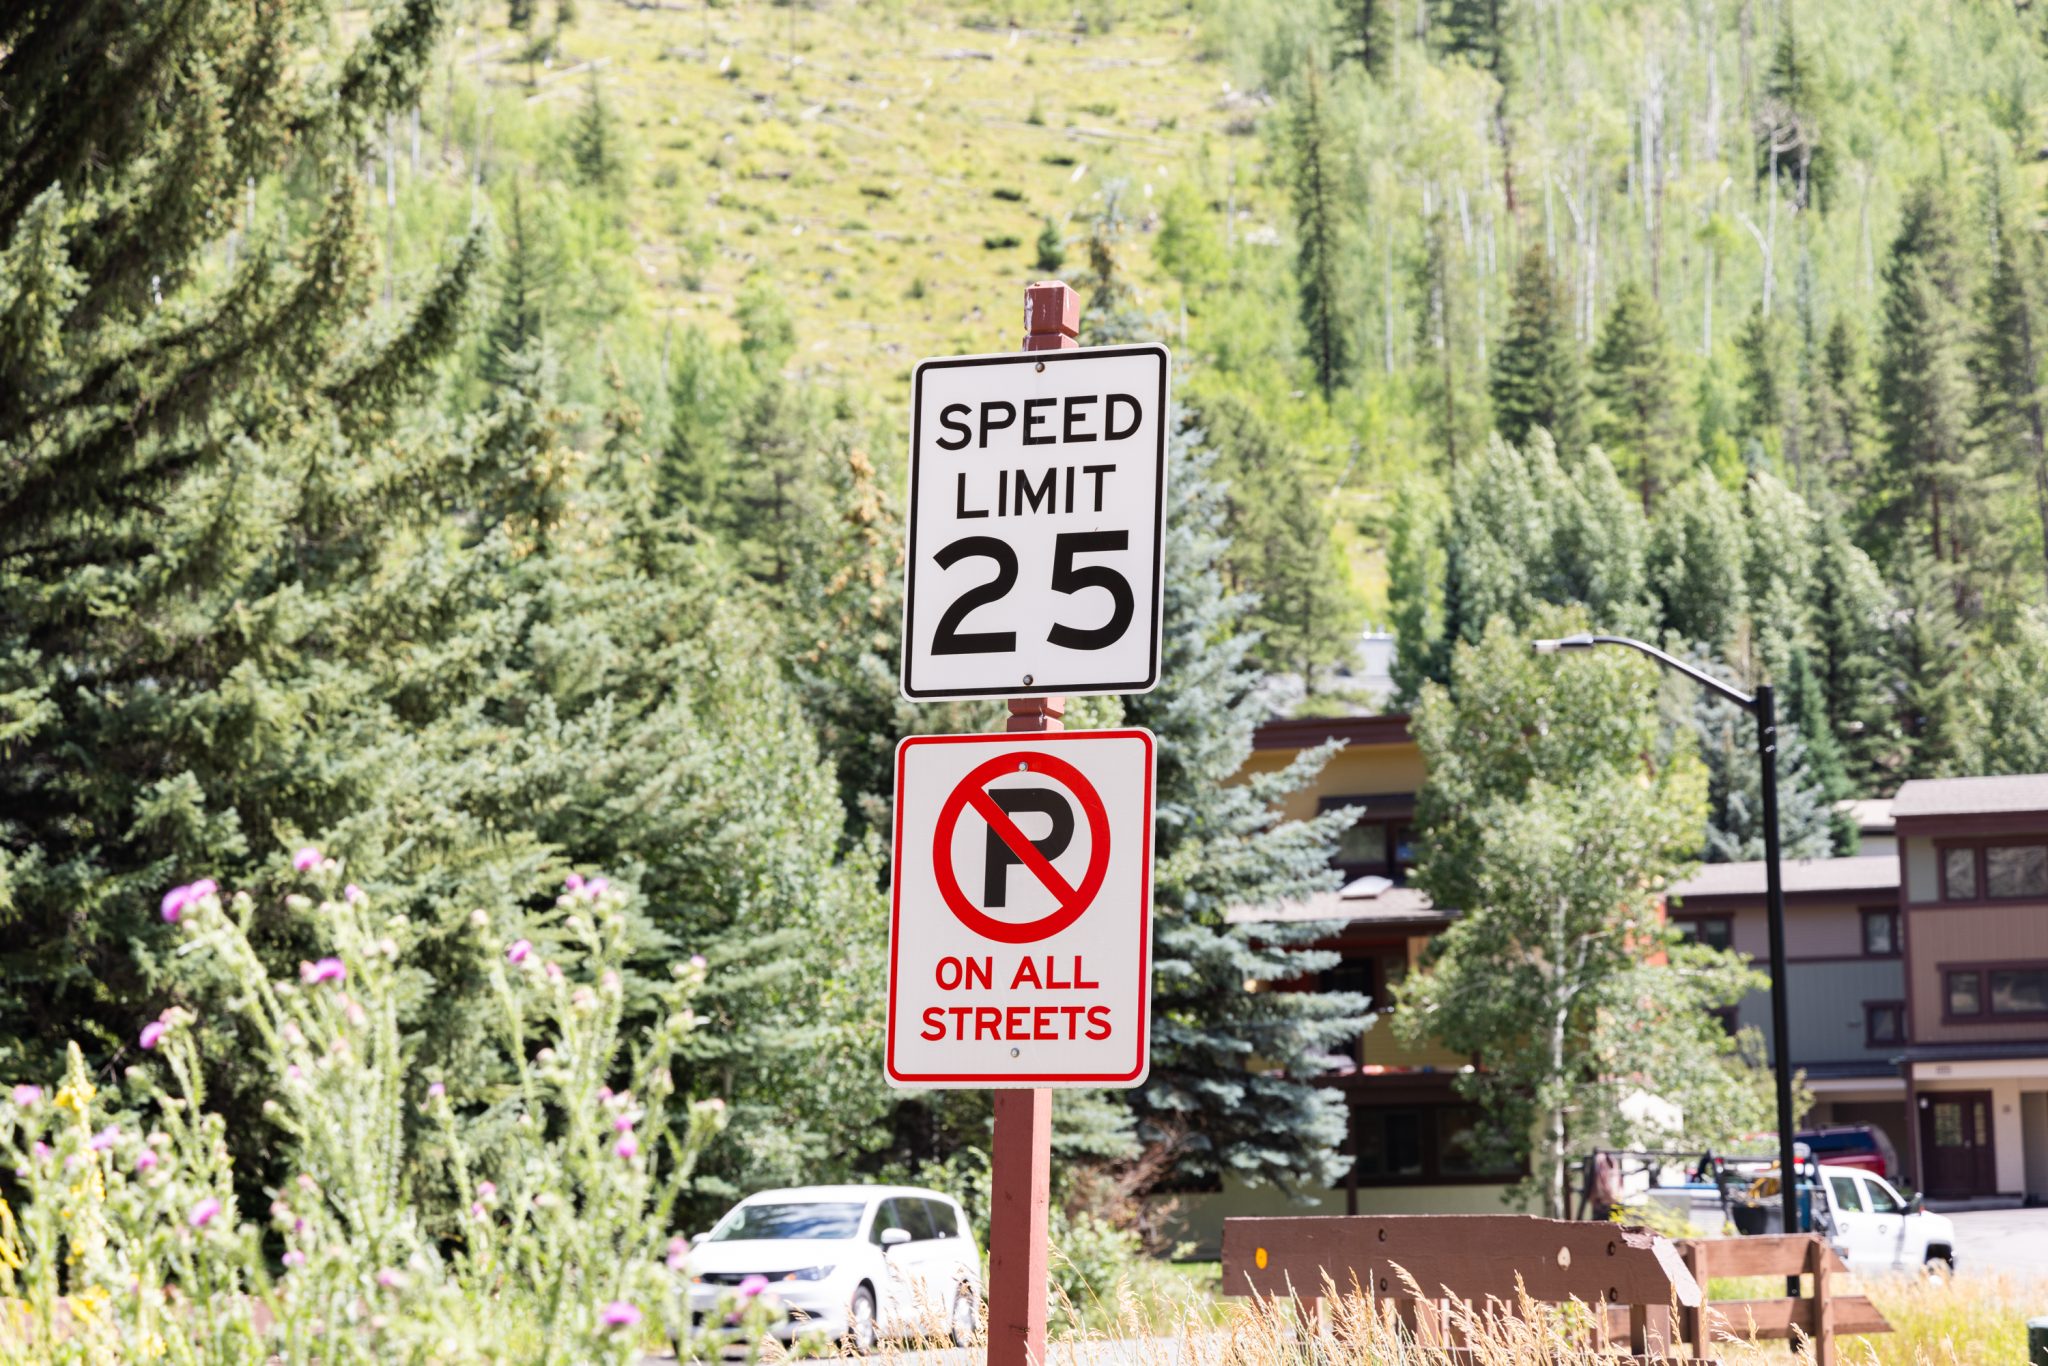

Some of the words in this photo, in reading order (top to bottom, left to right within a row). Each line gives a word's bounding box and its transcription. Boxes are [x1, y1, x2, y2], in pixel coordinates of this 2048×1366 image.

[936, 394, 1142, 450] SPEED
[957, 464, 1116, 519] LIMIT
[931, 530, 1134, 655] 25
[984, 788, 1074, 907] P
[936, 956, 992, 991] ON
[1010, 955, 1099, 990] ALL
[921, 1006, 1112, 1041] STREETS
